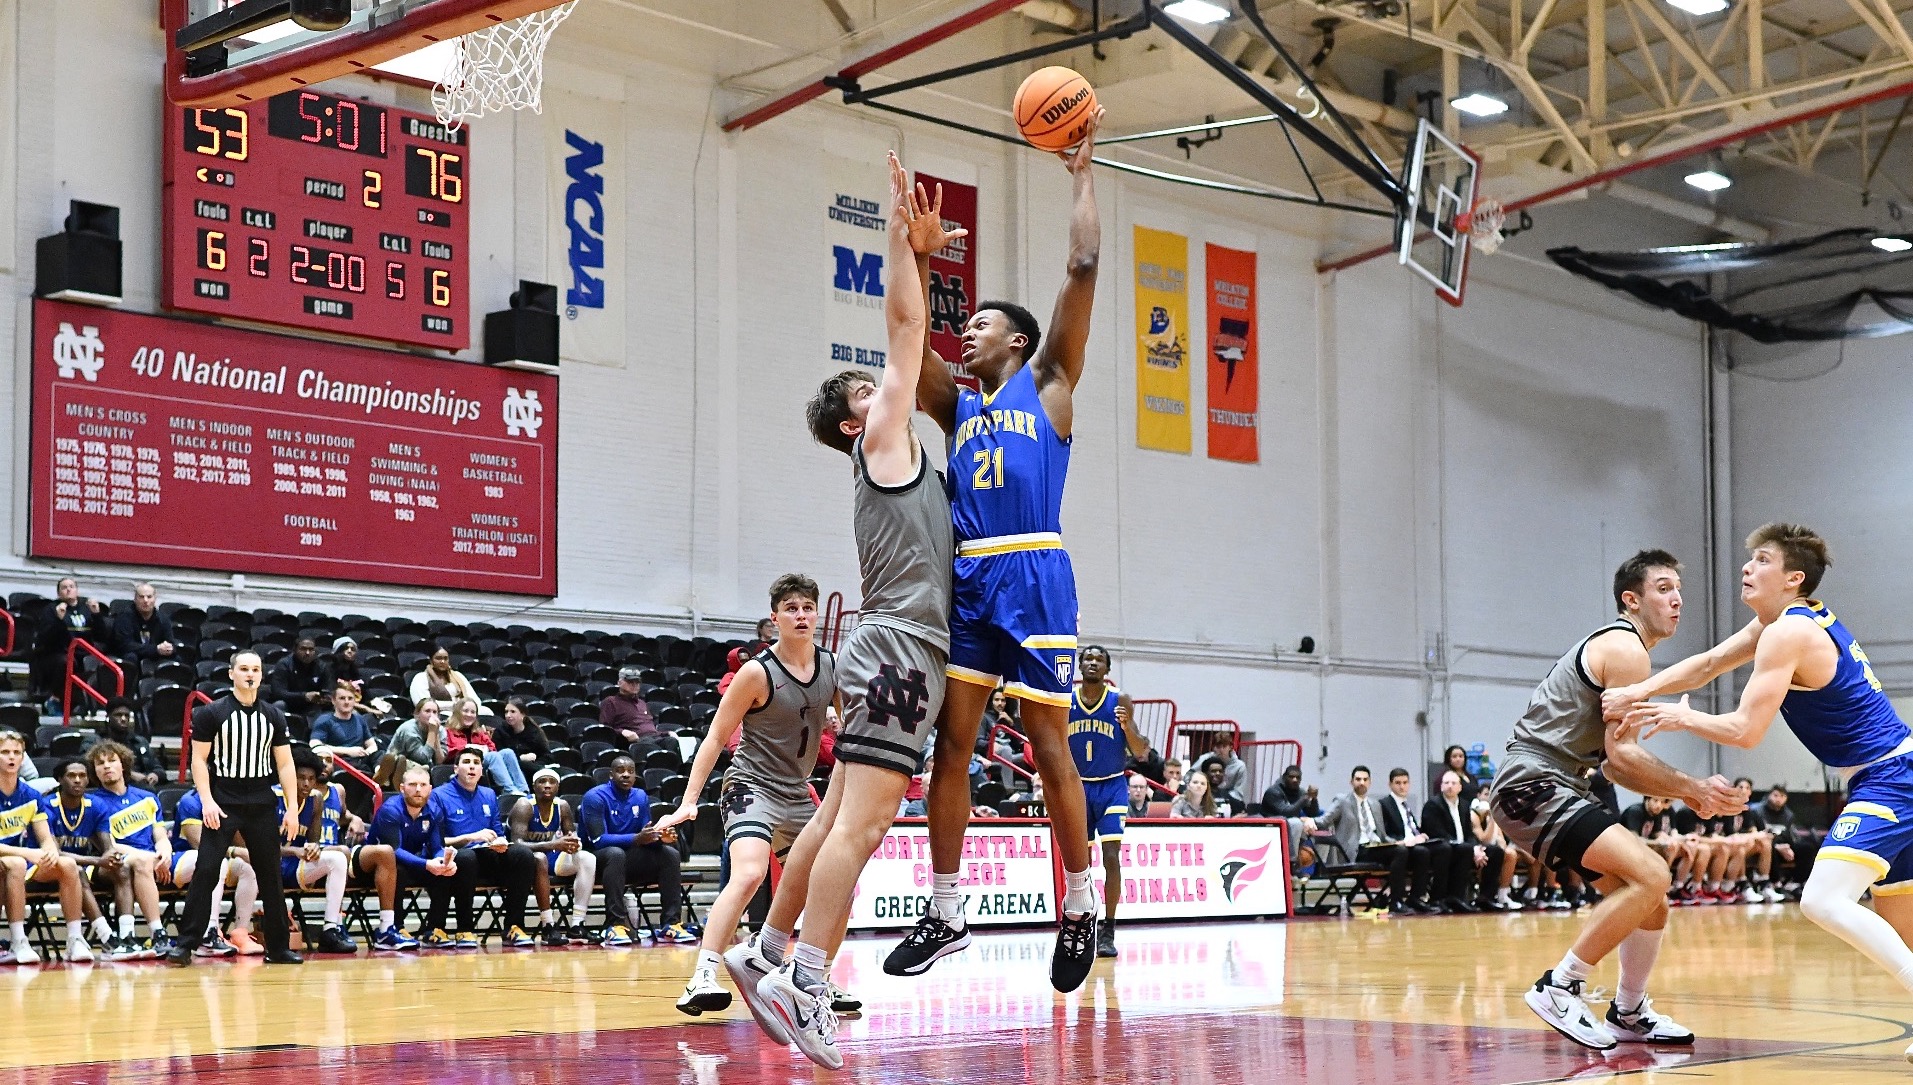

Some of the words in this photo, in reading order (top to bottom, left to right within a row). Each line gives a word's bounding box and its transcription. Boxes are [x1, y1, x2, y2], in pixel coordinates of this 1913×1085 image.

[1041, 87, 1089, 125] Wilson
[300, 92, 386, 154] 5:01
[195, 108, 248, 161] 53
[417, 148, 462, 203] 76
[306, 180, 344, 199] period
[363, 170, 382, 208] 2
[198, 200, 227, 220] fouls
[836, 193, 880, 214] MILLIKIN
[565, 128, 604, 309] NCAA
[829, 206, 886, 231] UNIVERSITY
[309, 221, 347, 240] player
[206, 231, 226, 271] 6
[250, 238, 268, 277] 2
[425, 241, 451, 259] fouls
[387, 262, 404, 299] 5
[833, 245, 884, 297] M
[201, 282, 224, 297] won
[432, 270, 450, 307] 6
[314, 299, 343, 315] game
[834, 290, 852, 305] BIG
[856, 295, 884, 310] BLUE
[427, 318, 448, 332] won
[831, 343, 852, 362] BIG
[855, 347, 886, 368] BLUE
[130, 346, 164, 378] 40
[172, 350, 287, 395] National
[297, 368, 481, 425] Championships
[1144, 395, 1185, 415] VIKINGS
[109, 409, 147, 425] CROSS
[991, 409, 1039, 443] PARK
[79, 422, 134, 440] COUNTRY
[210, 421, 252, 437] INDOOR
[266, 428, 302, 443] MEN'S
[305, 432, 355, 449] OUTDOOR
[170, 433, 206, 449] TRACK
[210, 438, 218, 450] &
[222, 440, 252, 454] FIELD
[389, 442, 421, 458] MEN'S
[272, 445, 306, 460] TRACK
[310, 450, 318, 461] &
[321, 451, 350, 465] FIELD
[470, 452, 517, 469] WOMEN'S
[371, 456, 428, 475] SWIMMING
[430, 464, 438, 476] &
[462, 467, 524, 485] BASKETBALL
[973, 447, 1004, 490] 21
[201, 469, 227, 485] 2017,
[228, 471, 251, 486] 2019
[369, 472, 404, 488] DIVING
[407, 478, 441, 492] (NAIA)
[138, 490, 160, 505] 2014
[326, 484, 346, 499] 2011
[284, 514, 338, 531] FOOTBALL
[471, 513, 518, 528] WOMEN'S
[300, 532, 322, 547] 2019
[452, 526, 504, 542] TRIATHLON
[506, 532, 537, 545] (USAT)
[497, 545, 517, 558] 2019
[1058, 663, 1071, 683] NP
[1092, 719, 1114, 740] PARK
[797, 726, 809, 759] 1
[1086, 740, 1092, 762] 1
[113, 810, 149, 834] VIKINGS
[1833, 822, 1858, 839] NP
[872, 836, 930, 859] ORT
[962, 836, 1047, 859] ENTRAL
[1137, 844, 1160, 867] OF
[1166, 843, 1205, 866] THE
[1095, 878, 1207, 904] DINALS
[875, 894, 971, 918] GREGY
[978, 893, 1047, 916] ARENA
